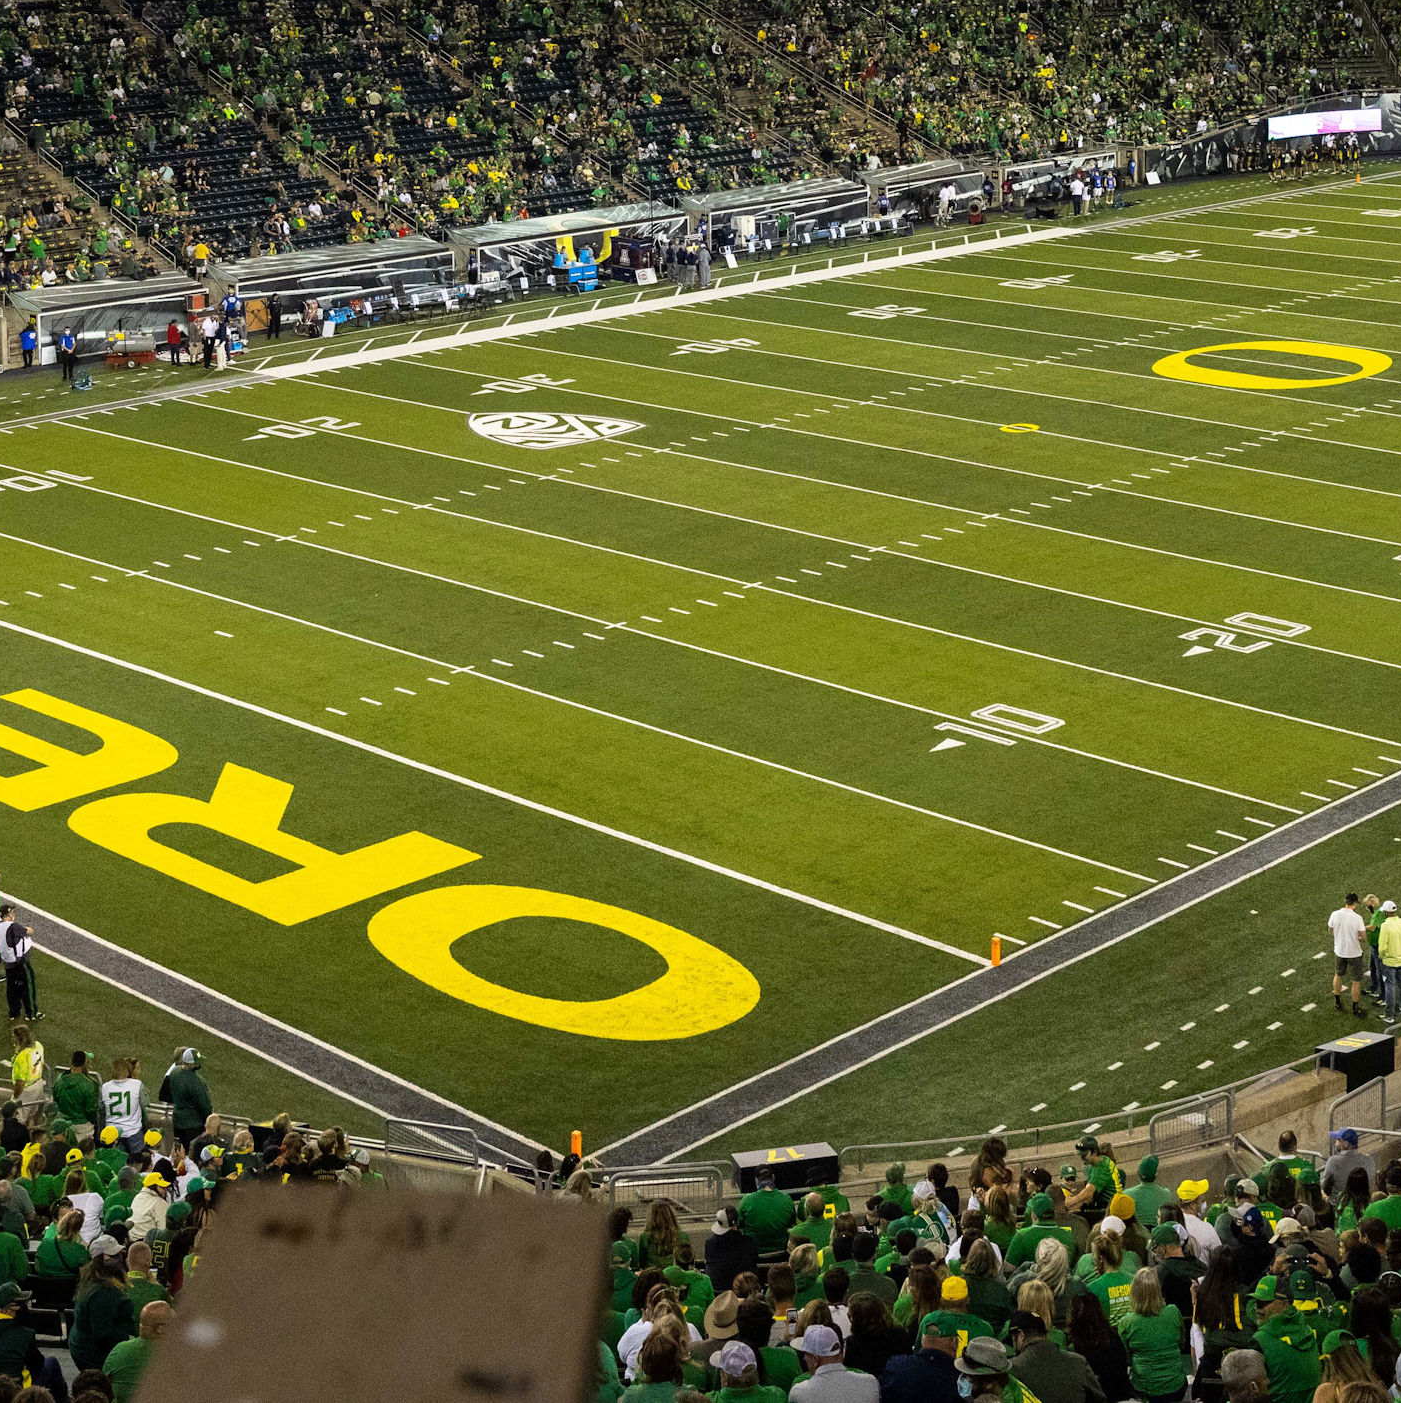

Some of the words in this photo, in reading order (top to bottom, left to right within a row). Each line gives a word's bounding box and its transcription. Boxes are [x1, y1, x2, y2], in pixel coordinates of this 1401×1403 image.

[844, 304, 928, 319] 50
[675, 337, 761, 355] 40
[1150, 340, 1393, 390] O
[480, 373, 578, 394] 30
[257, 416, 363, 440] 20
[999, 423, 1040, 434] O
[1178, 612, 1312, 653] 20
[933, 703, 1066, 746] 10
[107, 1091, 132, 1118] 21
[766, 1147, 805, 1163] 17
